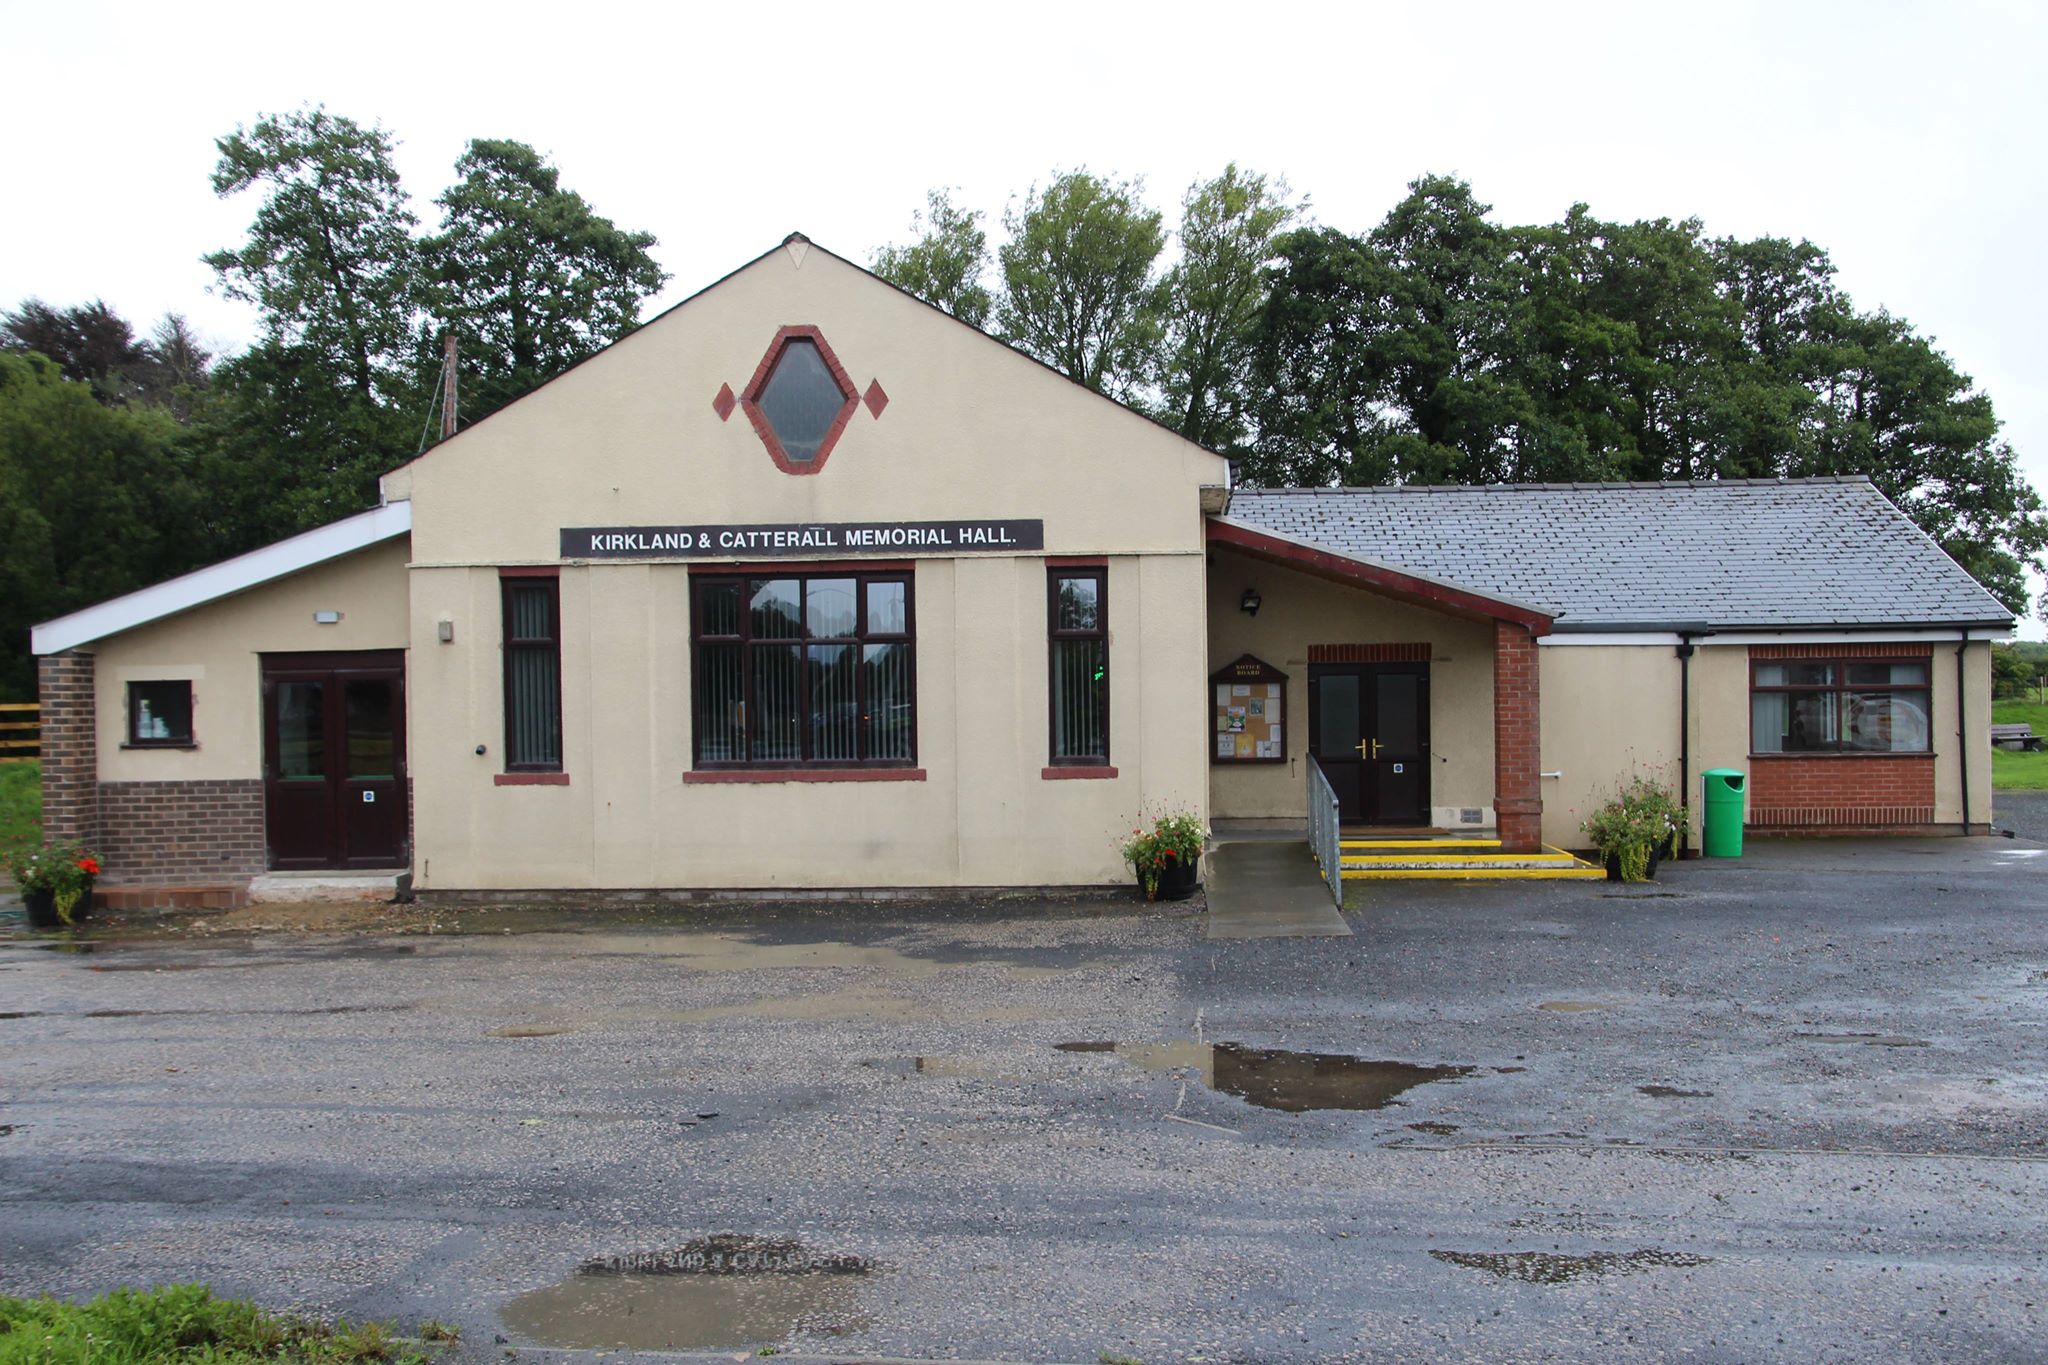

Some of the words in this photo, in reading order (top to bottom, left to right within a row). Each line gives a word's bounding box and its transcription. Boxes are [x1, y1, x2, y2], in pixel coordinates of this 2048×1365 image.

[591, 533, 693, 550] KIRKLAND
[698, 532, 712, 549] &
[719, 530, 838, 547] CATTERALL
[845, 528, 953, 545] MEMORIAL
[959, 527, 1017, 543] HALL.
